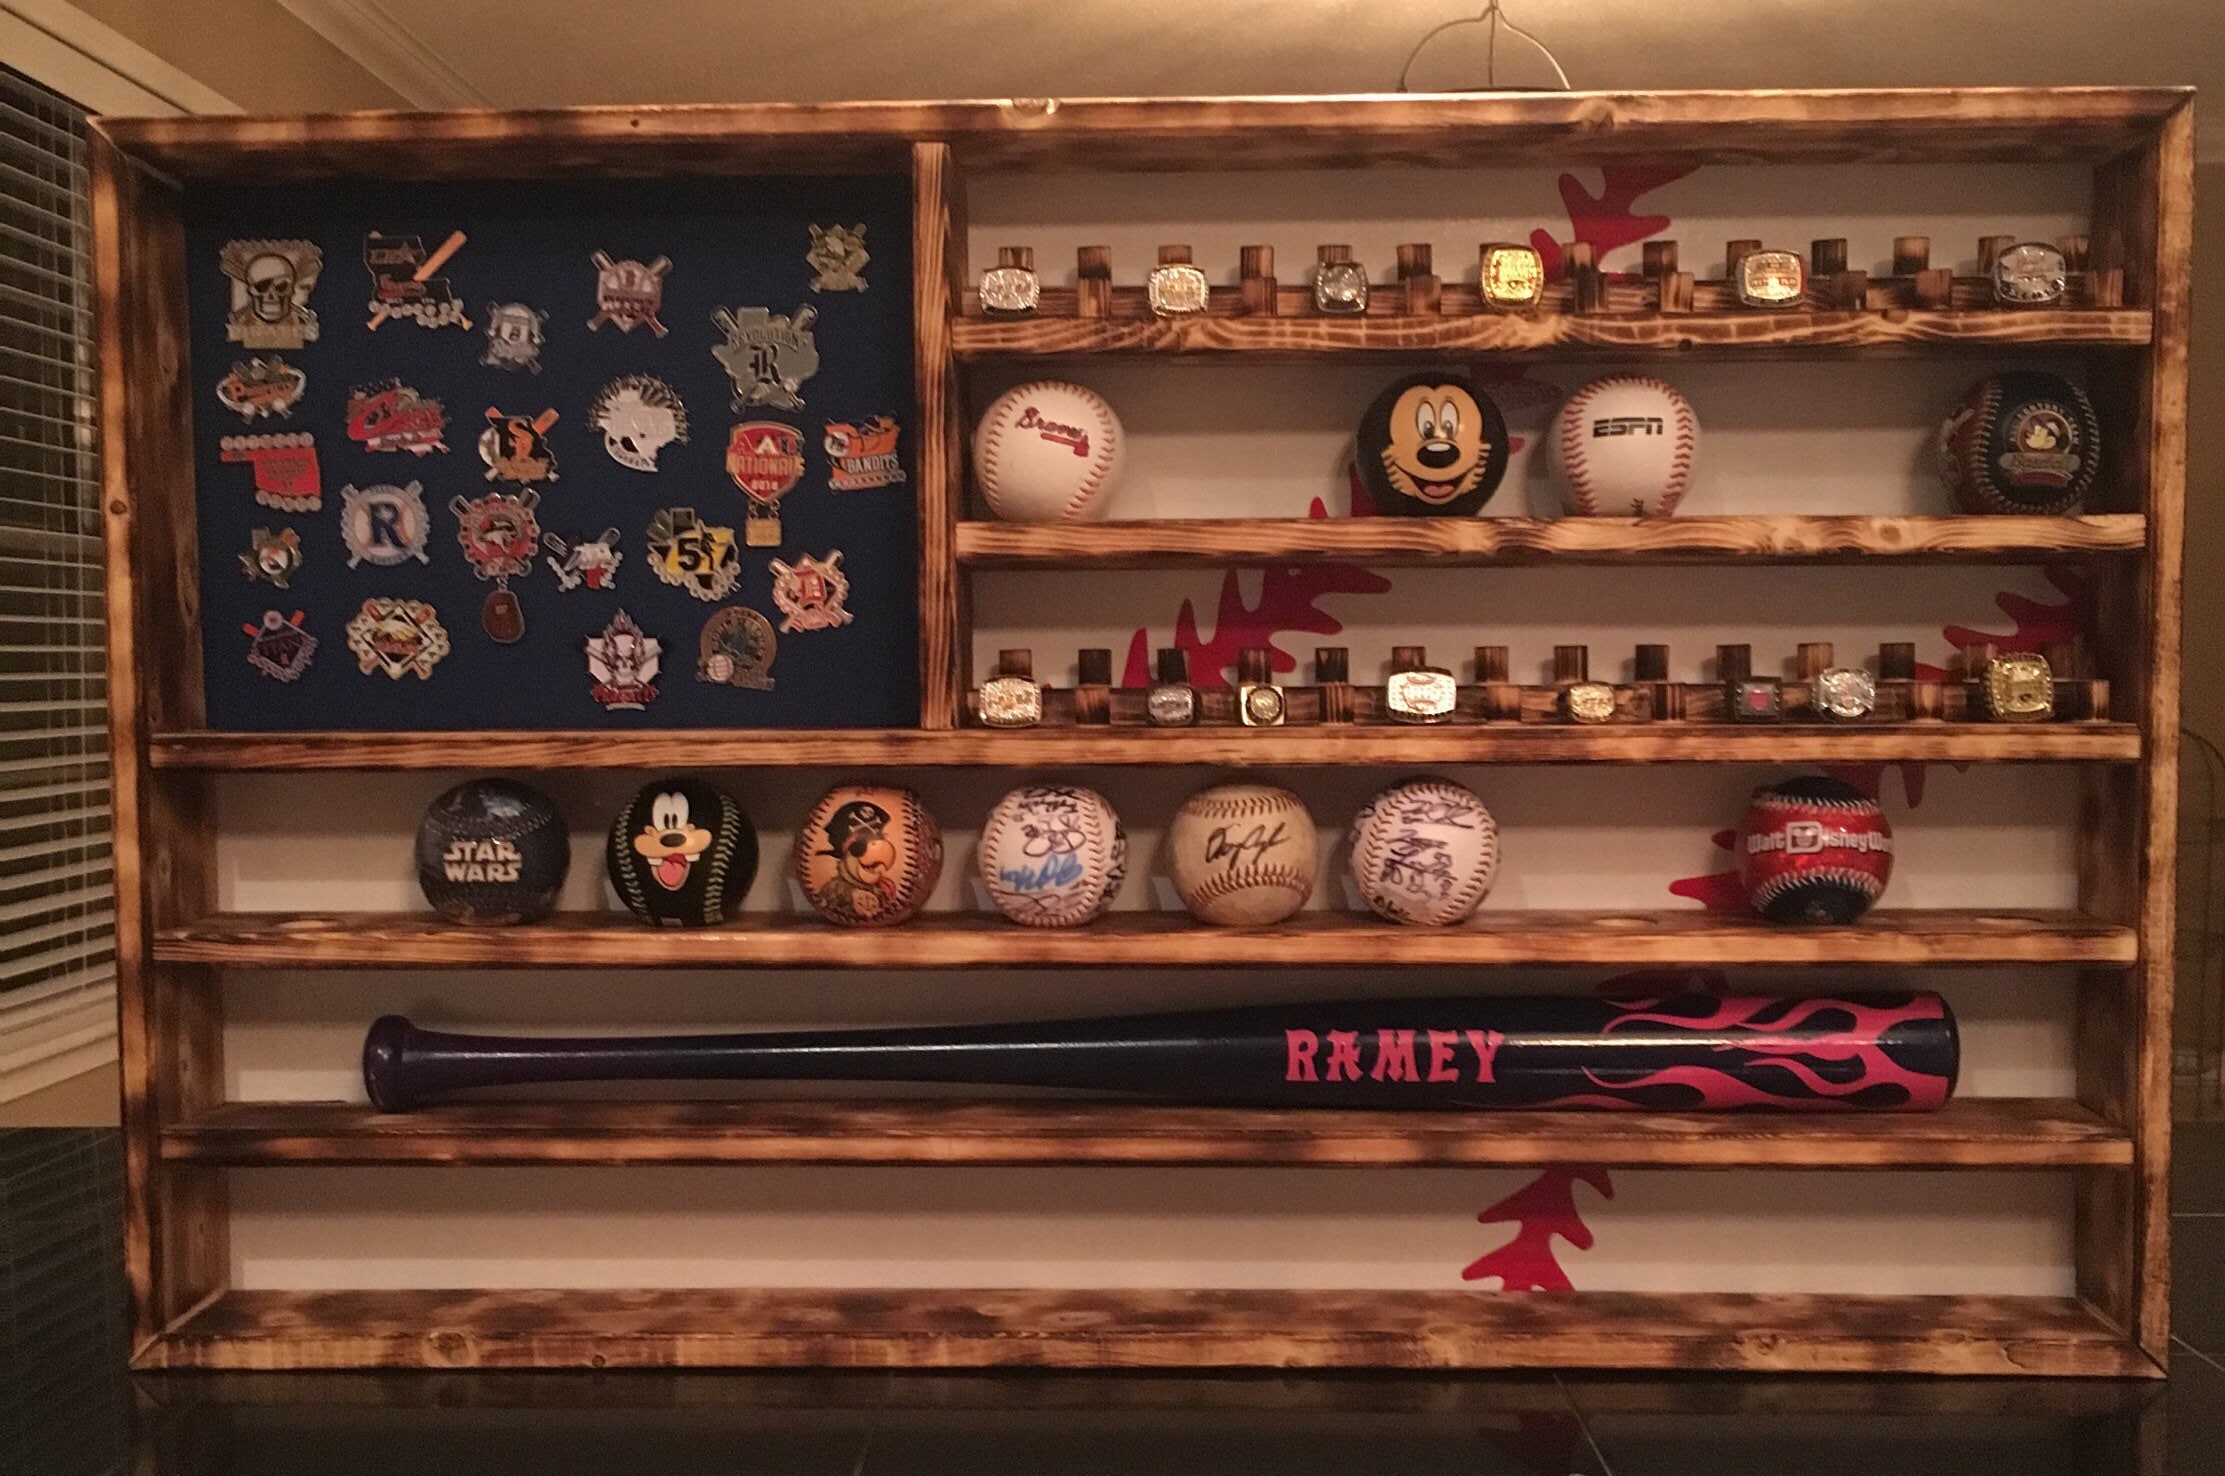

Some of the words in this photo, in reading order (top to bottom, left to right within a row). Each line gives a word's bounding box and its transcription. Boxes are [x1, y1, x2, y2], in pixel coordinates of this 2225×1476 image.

[1593, 417, 1663, 438] ESPN
[845, 452, 899, 475] BANDITS
[365, 501, 407, 549] R
[443, 840, 522, 861] STAR
[443, 861, 522, 883] WARS
[1285, 1029, 1504, 1083] RAMEY
